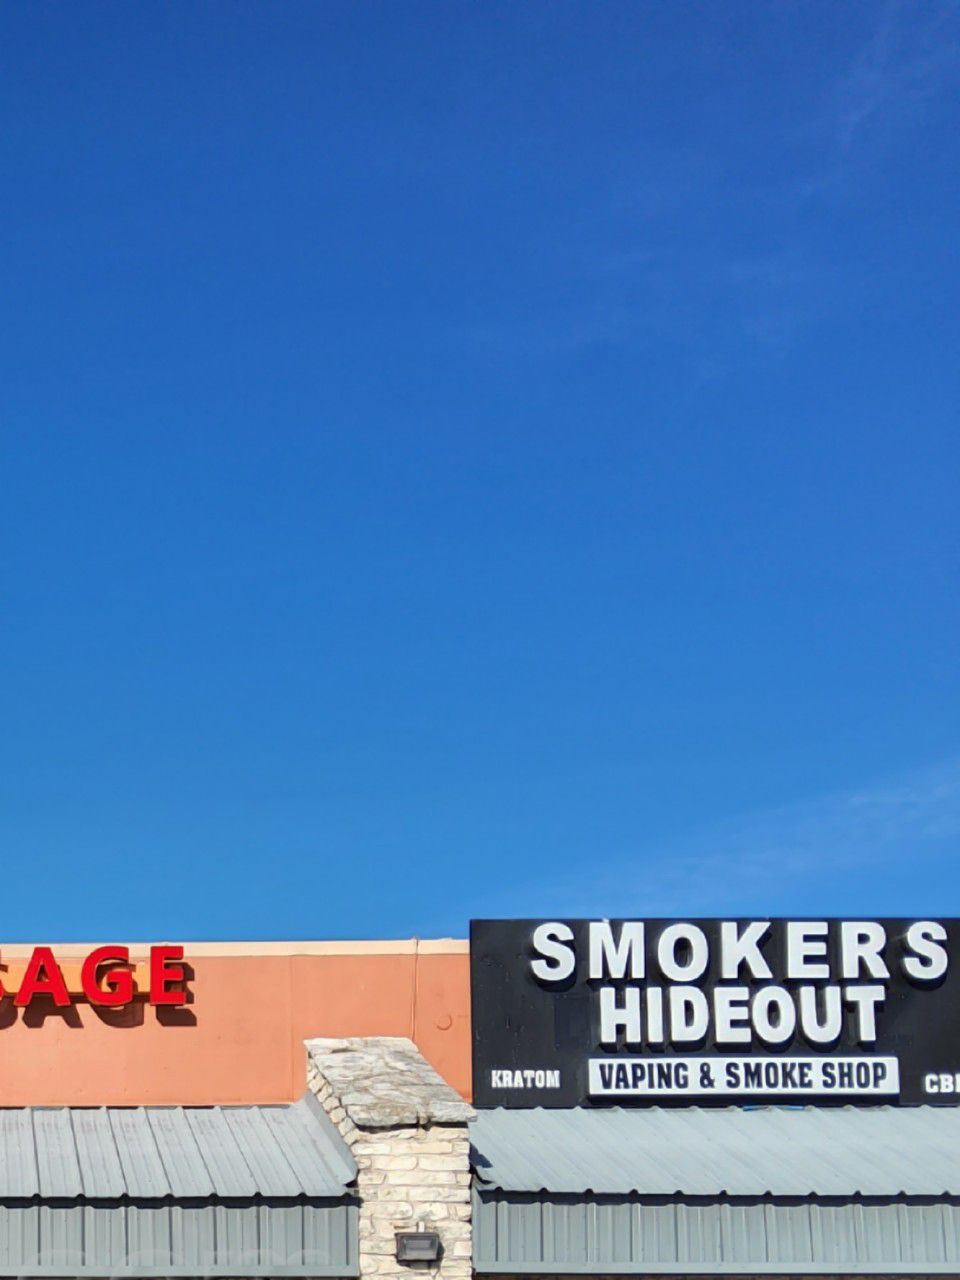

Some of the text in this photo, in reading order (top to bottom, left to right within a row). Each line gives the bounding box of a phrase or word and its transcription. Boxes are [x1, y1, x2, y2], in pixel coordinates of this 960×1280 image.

[530, 920, 949, 982] SMOKERS
[598, 984, 886, 1044] HIDEOUT
[491, 1069, 561, 1089] KRATOM
[598, 1060, 888, 1090] VAPING & SMOKE SHOP
